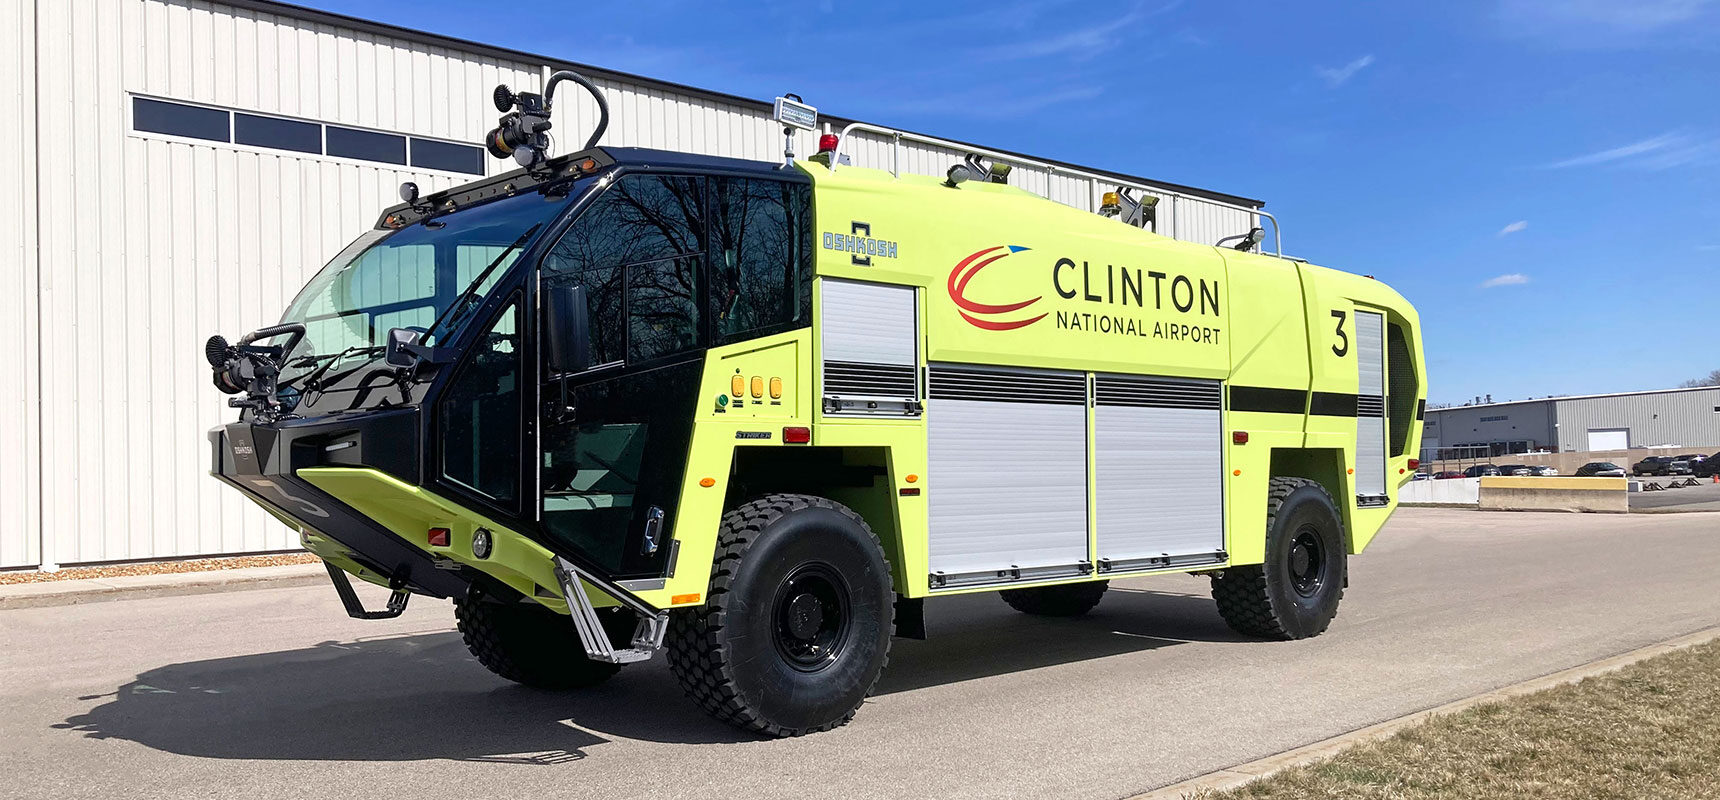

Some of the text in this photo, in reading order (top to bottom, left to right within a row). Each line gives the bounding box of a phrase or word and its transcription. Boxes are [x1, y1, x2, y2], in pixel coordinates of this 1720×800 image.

[823, 231, 898, 259] OSHKOSH
[1053, 257, 1219, 317] CLINTON
[1056, 310, 1221, 345] NATIONAL AIRPORT
[1330, 309, 1349, 358] 3
[735, 430, 772, 439] STRIKER
